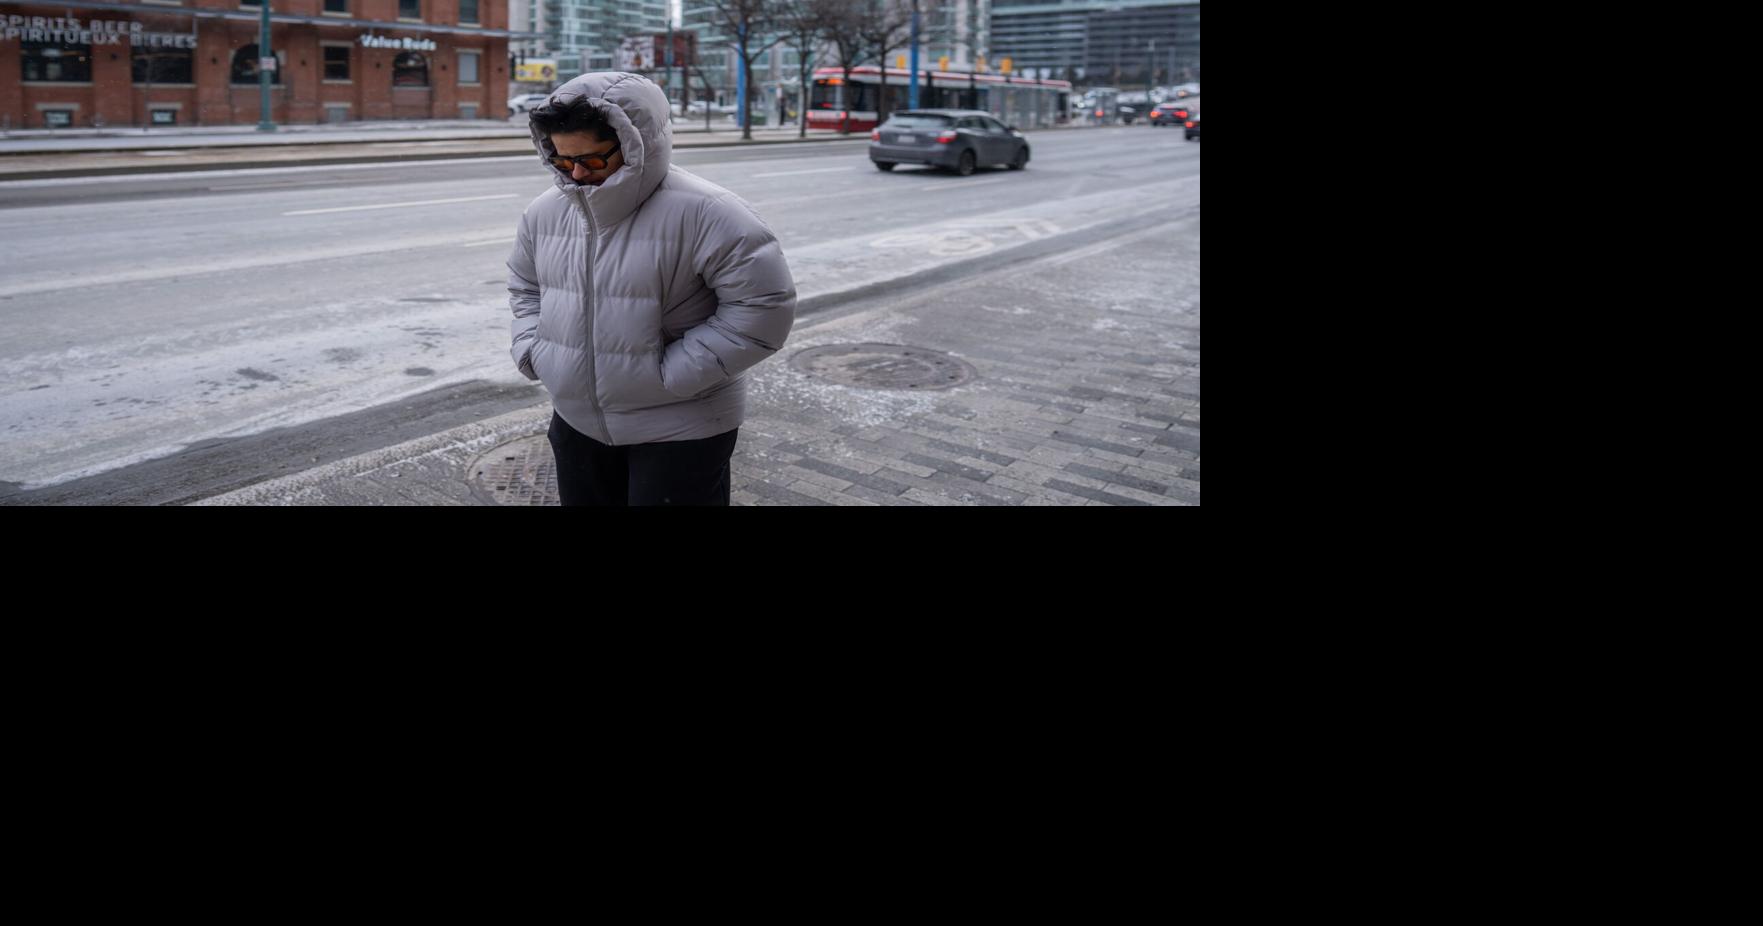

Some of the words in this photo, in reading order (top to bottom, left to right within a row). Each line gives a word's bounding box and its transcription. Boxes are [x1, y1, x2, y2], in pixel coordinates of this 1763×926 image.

[90, 19, 143, 34] BEER
[0, 27, 121, 45] PIRITUEUX
[360, 34, 401, 49] Value
